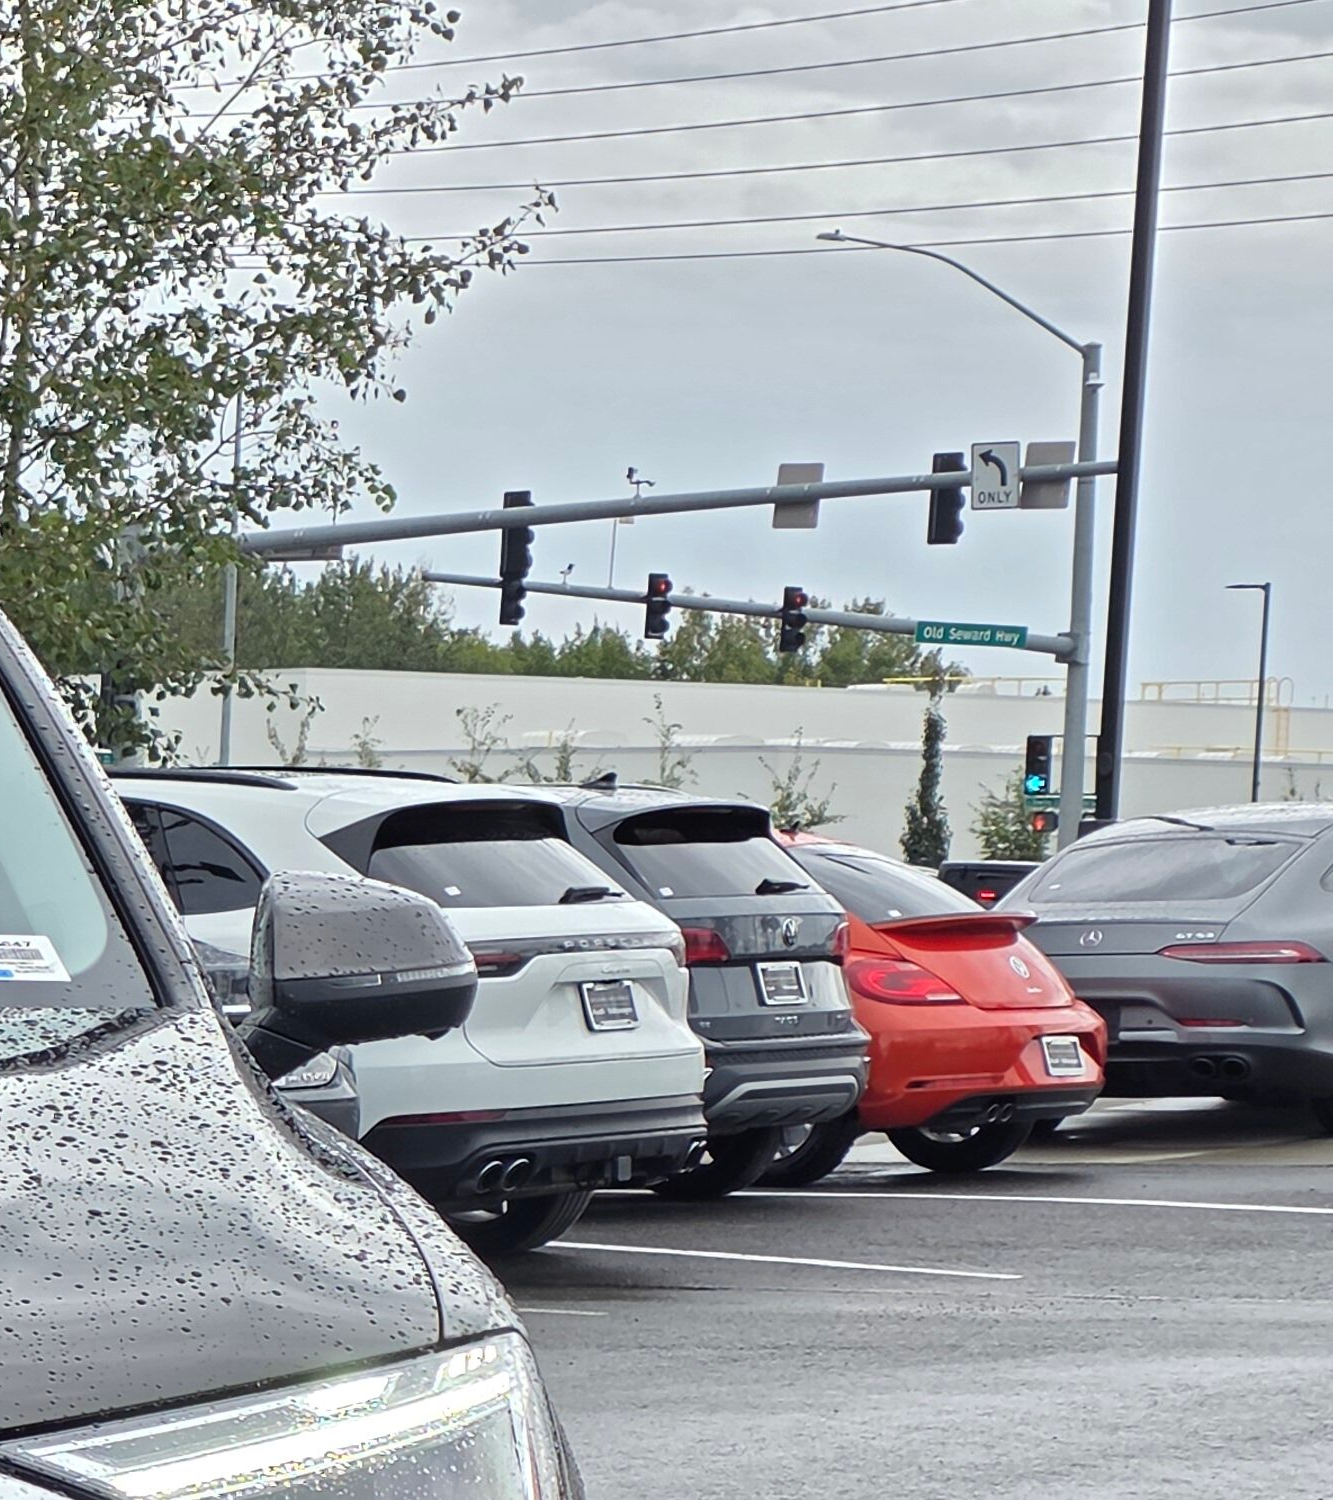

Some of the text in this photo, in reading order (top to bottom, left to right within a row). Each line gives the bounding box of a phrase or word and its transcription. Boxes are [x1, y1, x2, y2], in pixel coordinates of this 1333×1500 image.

[977, 490, 1012, 505] ONLY
[923, 625, 1021, 646] Old Seward Hwy
